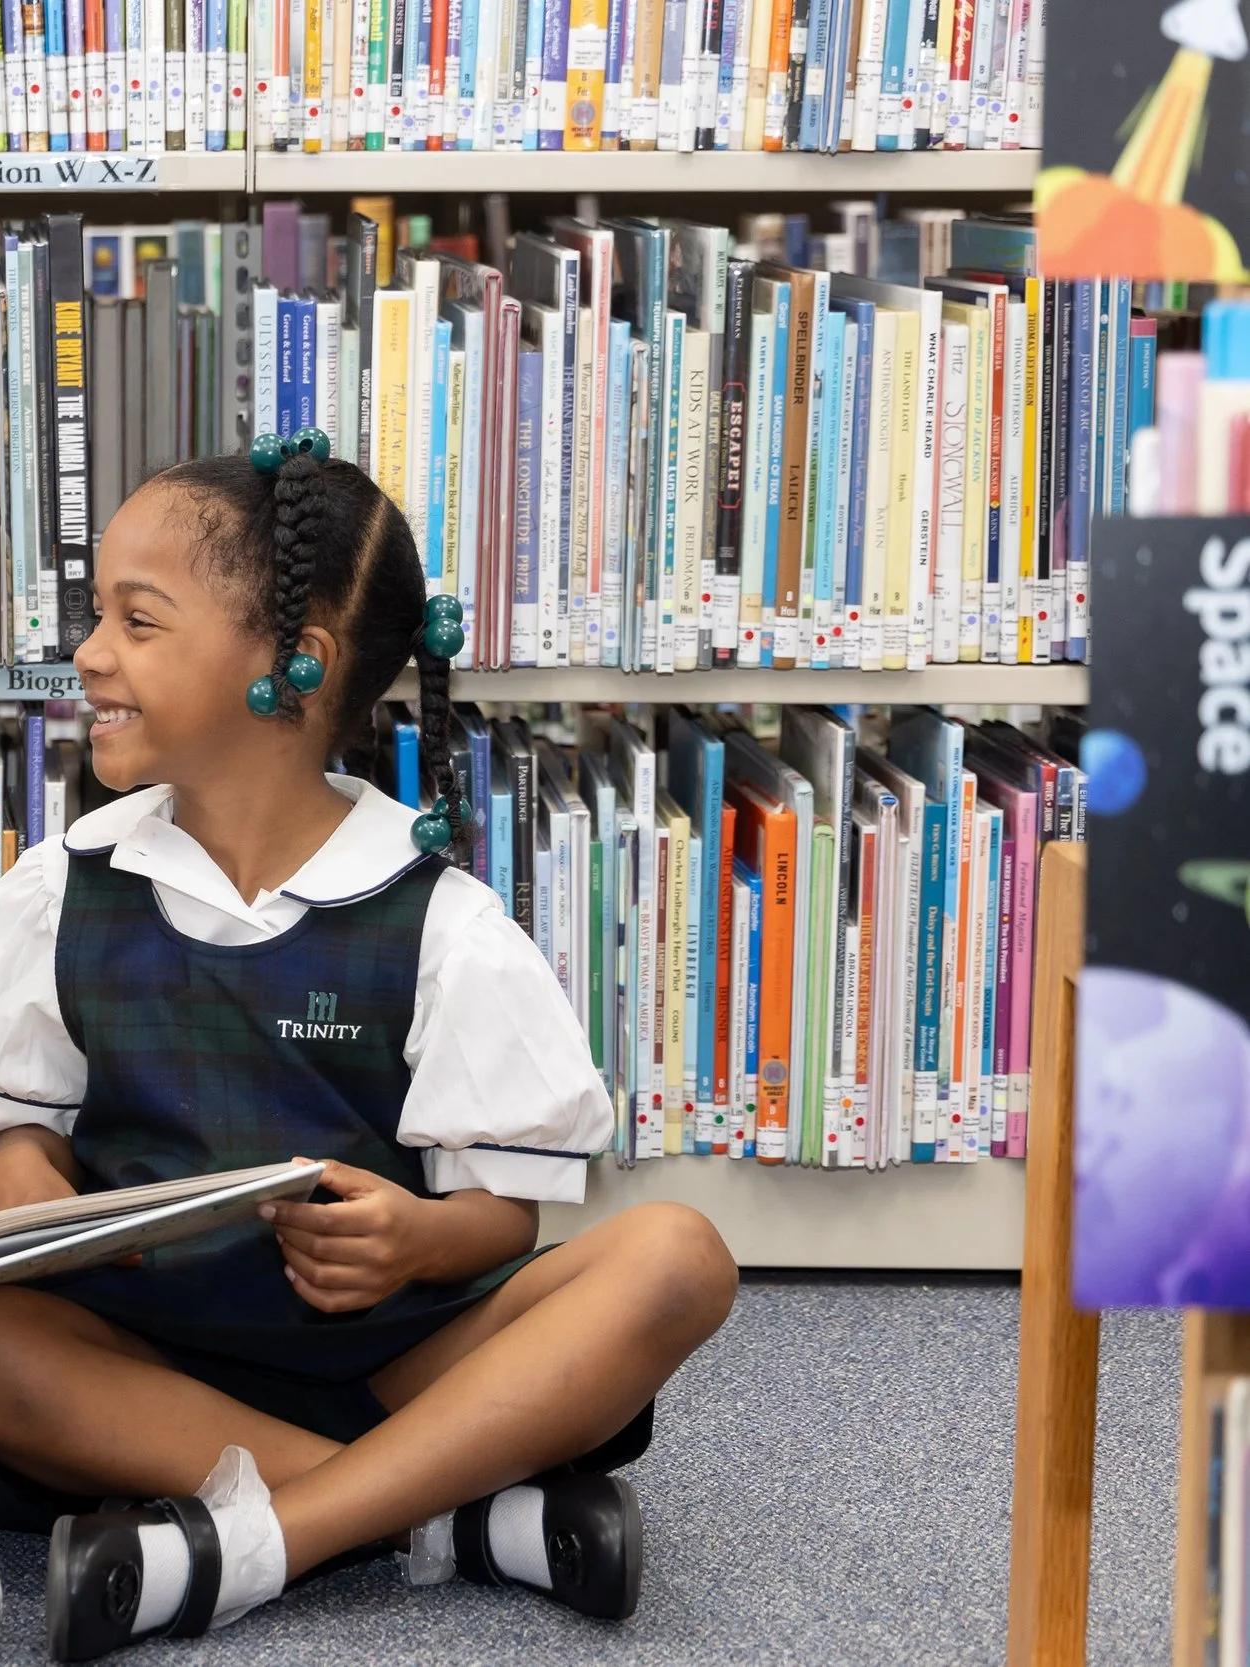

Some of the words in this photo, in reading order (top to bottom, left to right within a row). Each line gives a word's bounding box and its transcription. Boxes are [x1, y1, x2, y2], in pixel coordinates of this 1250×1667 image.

[814, 20, 828, 64] Builder
[54, 159, 85, 183] W
[98, 158, 157, 184] X-Z
[21, 284, 29, 305] THE
[20, 309, 30, 347] SHAPE
[55, 300, 80, 336] KOBE
[281, 314, 292, 341] Green
[300, 315, 311, 341] Green
[1026, 312, 1036, 354] THOMAS
[56, 339, 82, 388] BRYANT
[282, 344, 292, 352] &
[301, 344, 311, 352] &
[793, 311, 808, 405] SPELLBINDER
[927, 332, 937, 365] WHAT
[951, 344, 967, 375] Fritz
[1080, 351, 1091, 383] JOAN
[22, 349, 31, 386] GAME
[282, 353, 292, 383] Sanford
[301, 354, 312, 384] Sanford
[361, 369, 370, 397] WOODY
[1025, 355, 1036, 407] JEFFERSON
[58, 394, 83, 418] THE
[689, 369, 704, 413] KIDS
[925, 368, 935, 417] CHARLIE
[1080, 387, 1090, 402] OF
[22, 407, 33, 449] Anthony
[360, 400, 370, 433] GUTHRIE
[519, 419, 532, 449] THE
[687, 417, 701, 443] AT
[1079, 407, 1090, 435] ARC
[58, 422, 84, 472] MAMBA
[727, 401, 743, 491] ESCAPE!
[924, 419, 933, 458] HEARD
[24, 452, 34, 490] Browne
[685, 448, 700, 504] WORK
[60, 476, 86, 546] MENTALITY
[517, 457, 531, 545] LONGITUDE
[787, 464, 799, 521] LALICKI
[919, 510, 929, 566] GERSTEIN
[516, 554, 529, 595] PRIZE
[684, 525, 695, 592] FREEDMAN
[1182, 534, 1250, 775] Space
[517, 765, 529, 823] PARTRIDGE
[674, 839, 684, 878] Charles
[776, 852, 789, 906] LINCOLN
[670, 881, 682, 938] Lindbergh:
[672, 941, 682, 965] Hero
[684, 924, 698, 999] LINDBERGH
[672, 968, 682, 992] Pilot
[846, 952, 857, 997] ABRAHAM
[277, 1019, 362, 1040] TRINITY
[845, 1000, 855, 1038] LINCOLN
